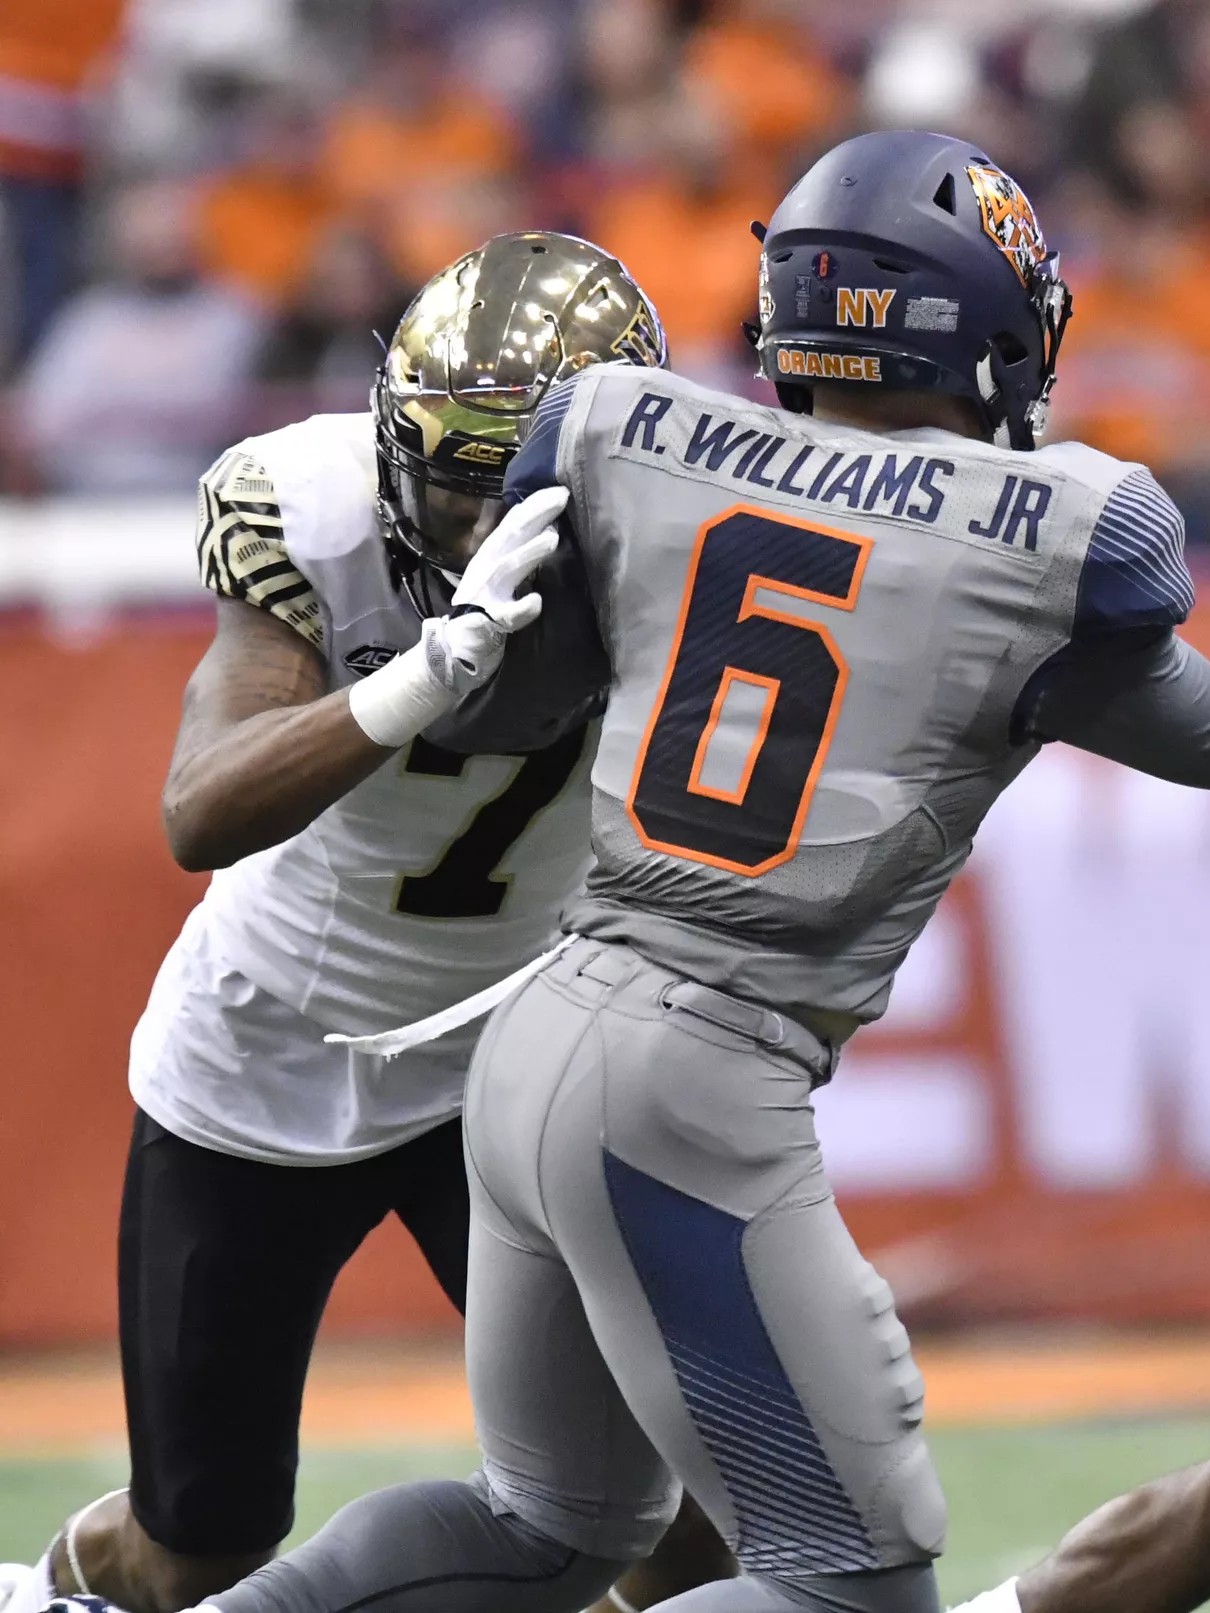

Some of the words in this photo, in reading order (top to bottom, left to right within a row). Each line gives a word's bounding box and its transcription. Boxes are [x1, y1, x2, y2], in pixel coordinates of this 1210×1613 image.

[820, 251, 829, 277] 6
[836, 287, 896, 328] NY
[777, 348, 882, 382] ORANGE
[457, 442, 505, 460] ACC
[621, 392, 673, 454] R.
[683, 414, 954, 523] WILLIAMS
[969, 475, 1053, 552] JR
[351, 650, 393, 667] AC
[625, 502, 874, 879] 6
[390, 727, 596, 921] 7
